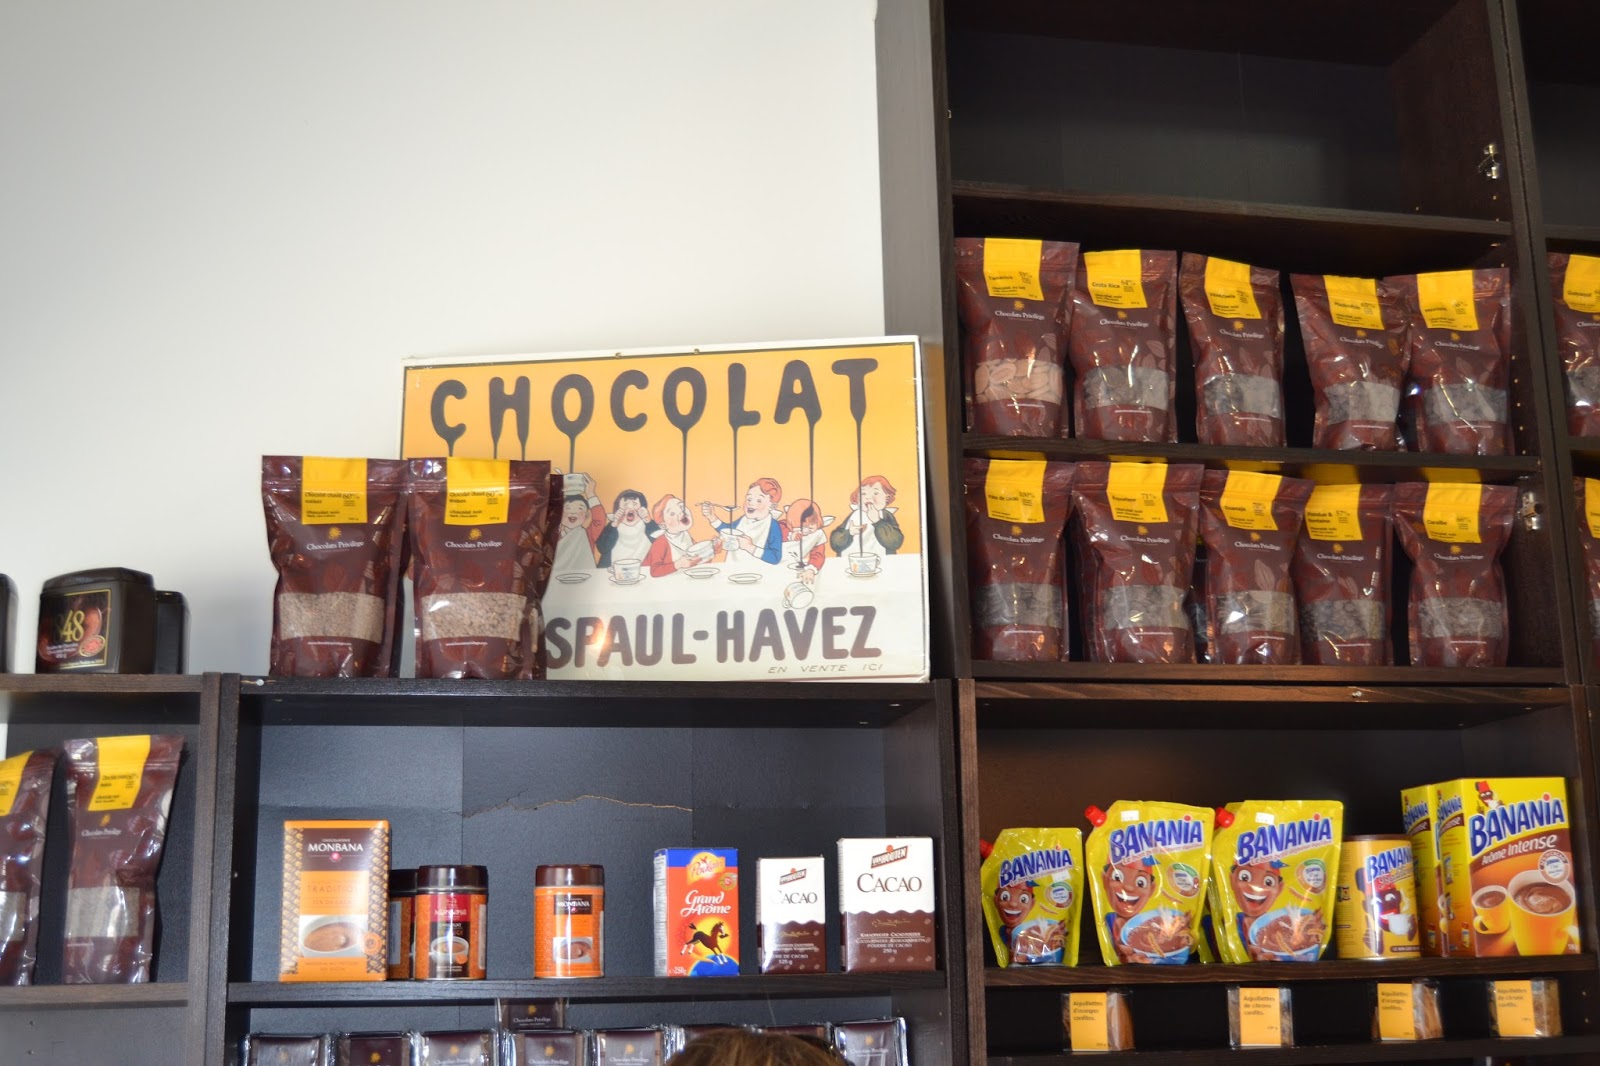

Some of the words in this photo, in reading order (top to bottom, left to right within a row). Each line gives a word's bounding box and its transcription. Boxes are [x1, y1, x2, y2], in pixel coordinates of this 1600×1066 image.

[430, 357, 880, 445] CHOCOLAT
[306, 542, 337, 551] Chocolats
[767, 666, 788, 674] EN
[800, 664, 848, 673] VENTE
[862, 662, 884, 671] ICI
[1469, 793, 1565, 857] BANANIA
[308, 843, 364, 852] MONBANA
[1110, 814, 1203, 865] BANANIA
[1237, 813, 1332, 866] BANANIA
[1482, 848, 1506, 865] Arôme
[1508, 834, 1557, 856] Intense
[1000, 846, 1073, 888] BANANIA
[307, 884, 361, 893] TRADITIO
[857, 873, 922, 893] CACAO
[684, 889, 725, 905] Grand
[771, 888, 819, 905] ACAO
[680, 901, 732, 918] Arôme
